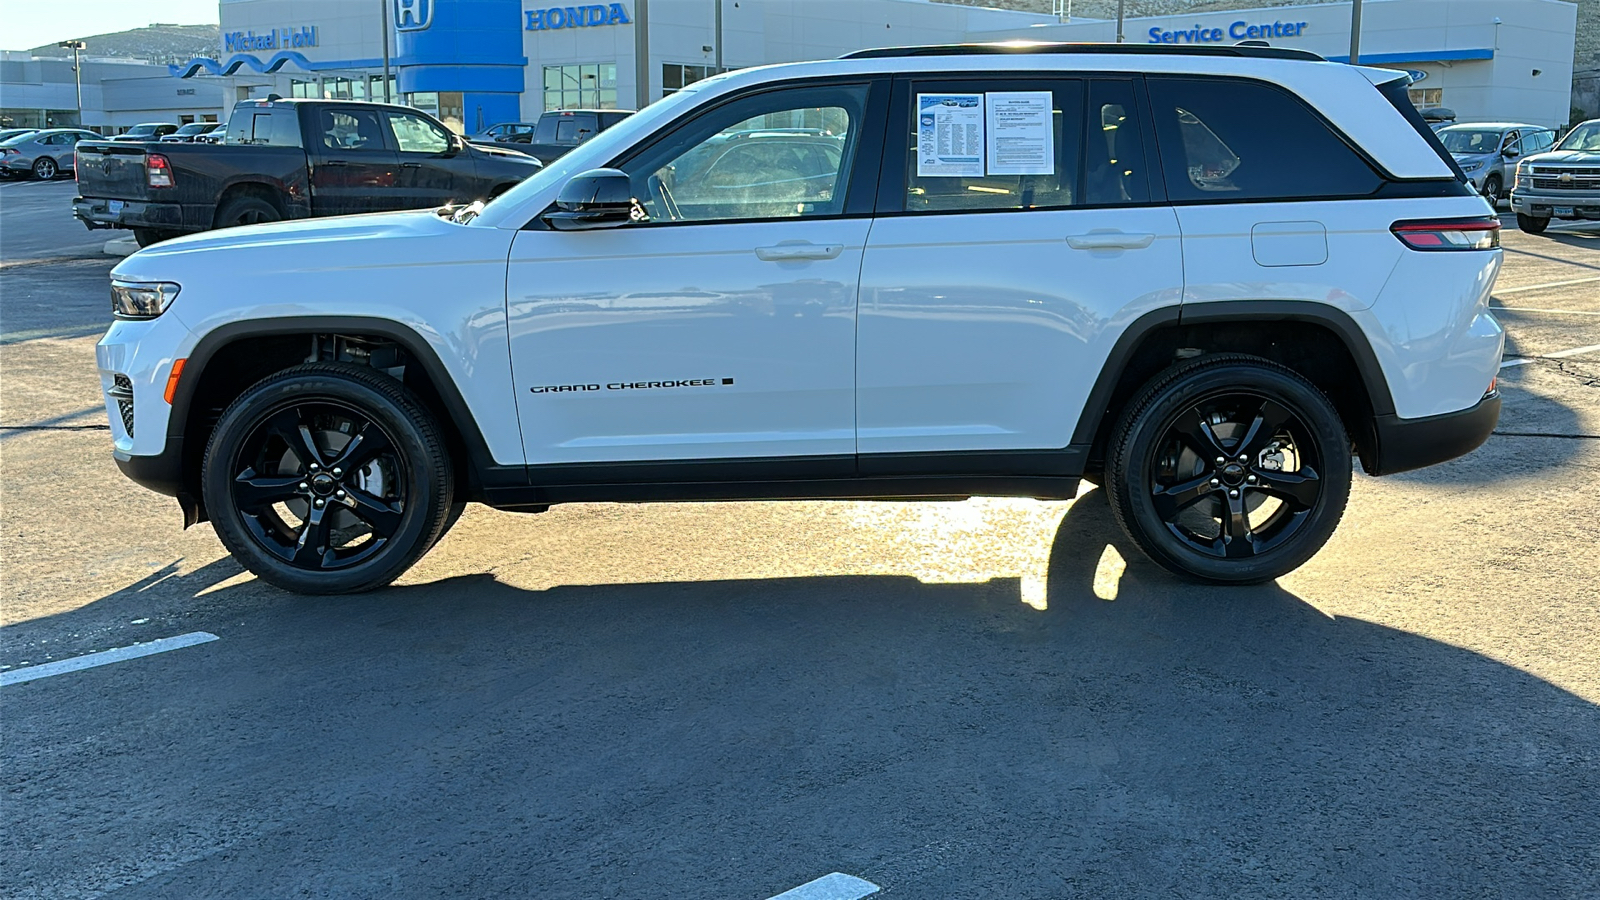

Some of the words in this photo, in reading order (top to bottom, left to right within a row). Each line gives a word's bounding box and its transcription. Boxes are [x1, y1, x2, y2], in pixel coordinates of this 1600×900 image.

[524, 3, 631, 31] HONDA
[225, 29, 279, 53] Michael
[280, 26, 319, 49] Hohl
[1148, 24, 1224, 44] Service
[1228, 20, 1307, 40] Center
[530, 383, 601, 394] GRAND
[606, 378, 715, 391] CHEROKEE
